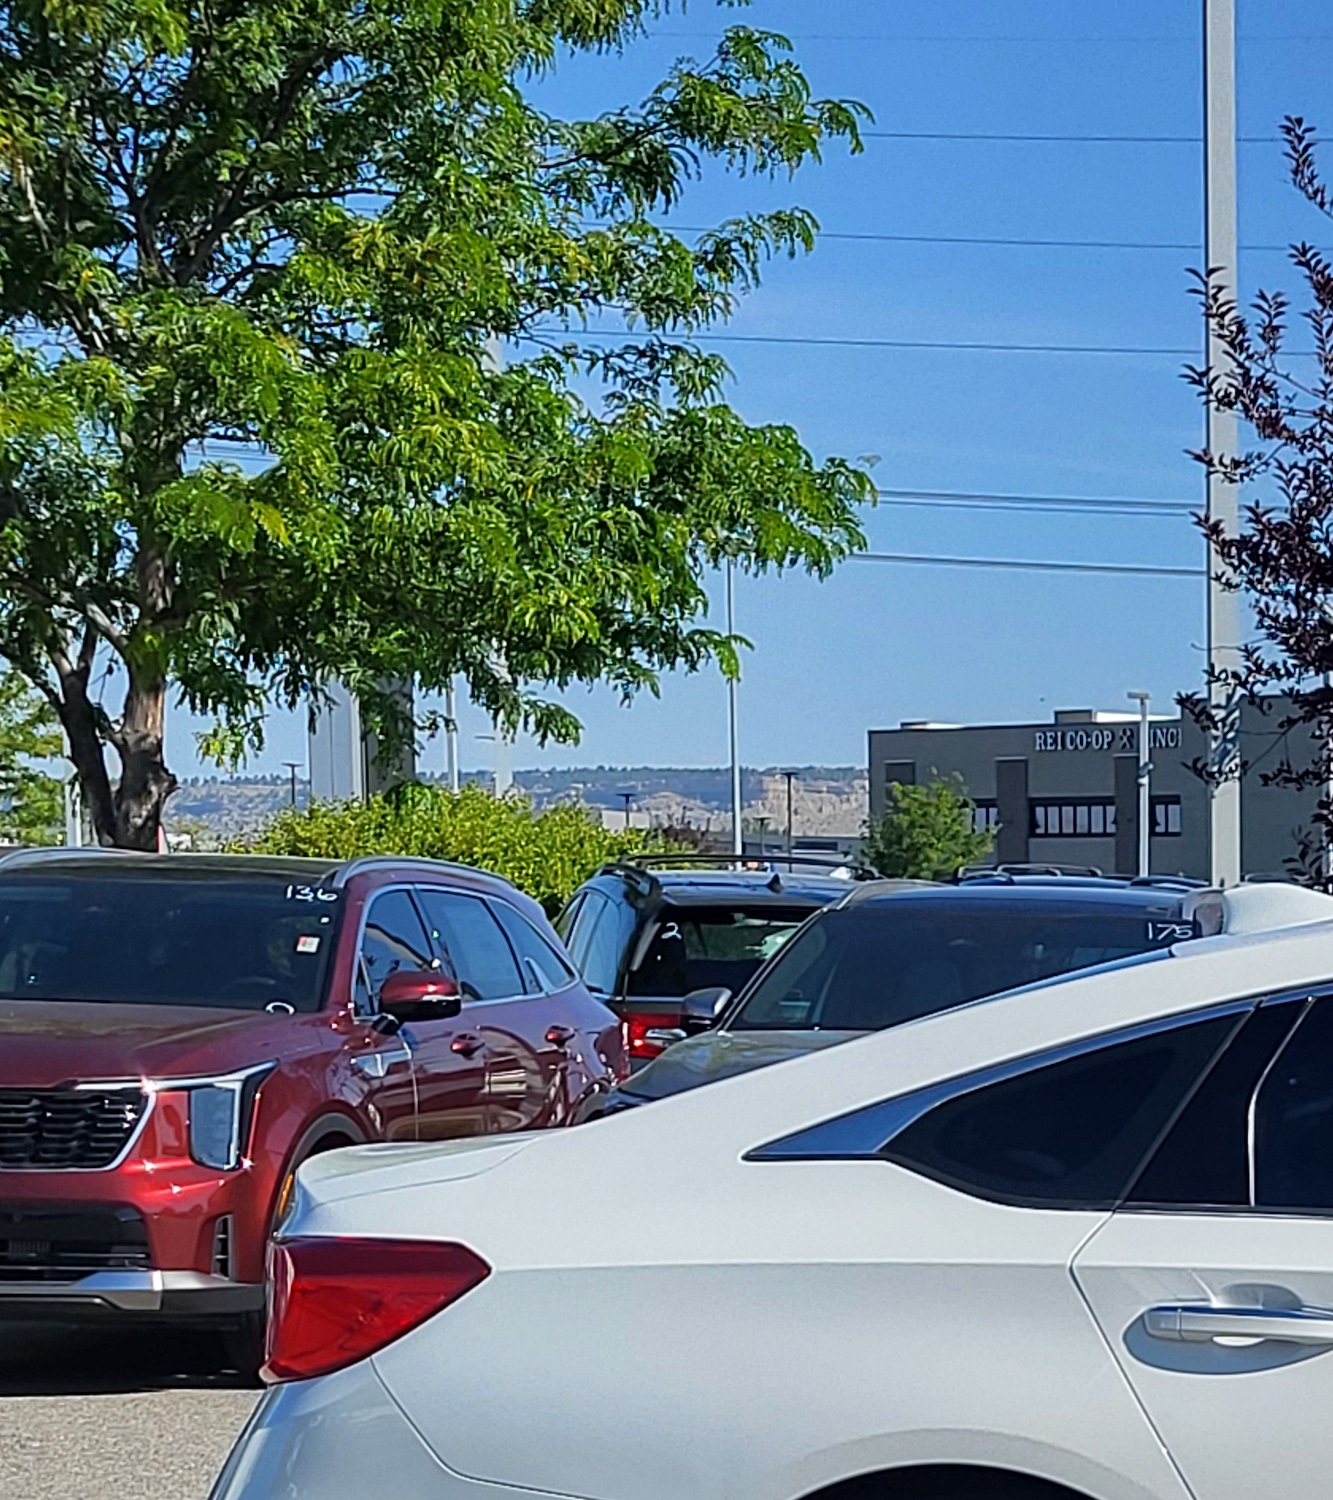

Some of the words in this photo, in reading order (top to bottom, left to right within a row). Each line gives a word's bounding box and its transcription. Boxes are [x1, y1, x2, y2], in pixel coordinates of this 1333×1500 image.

[1035, 731, 1063, 750] REI
[286, 885, 338, 902] 136
[1147, 921, 1193, 940] 175
